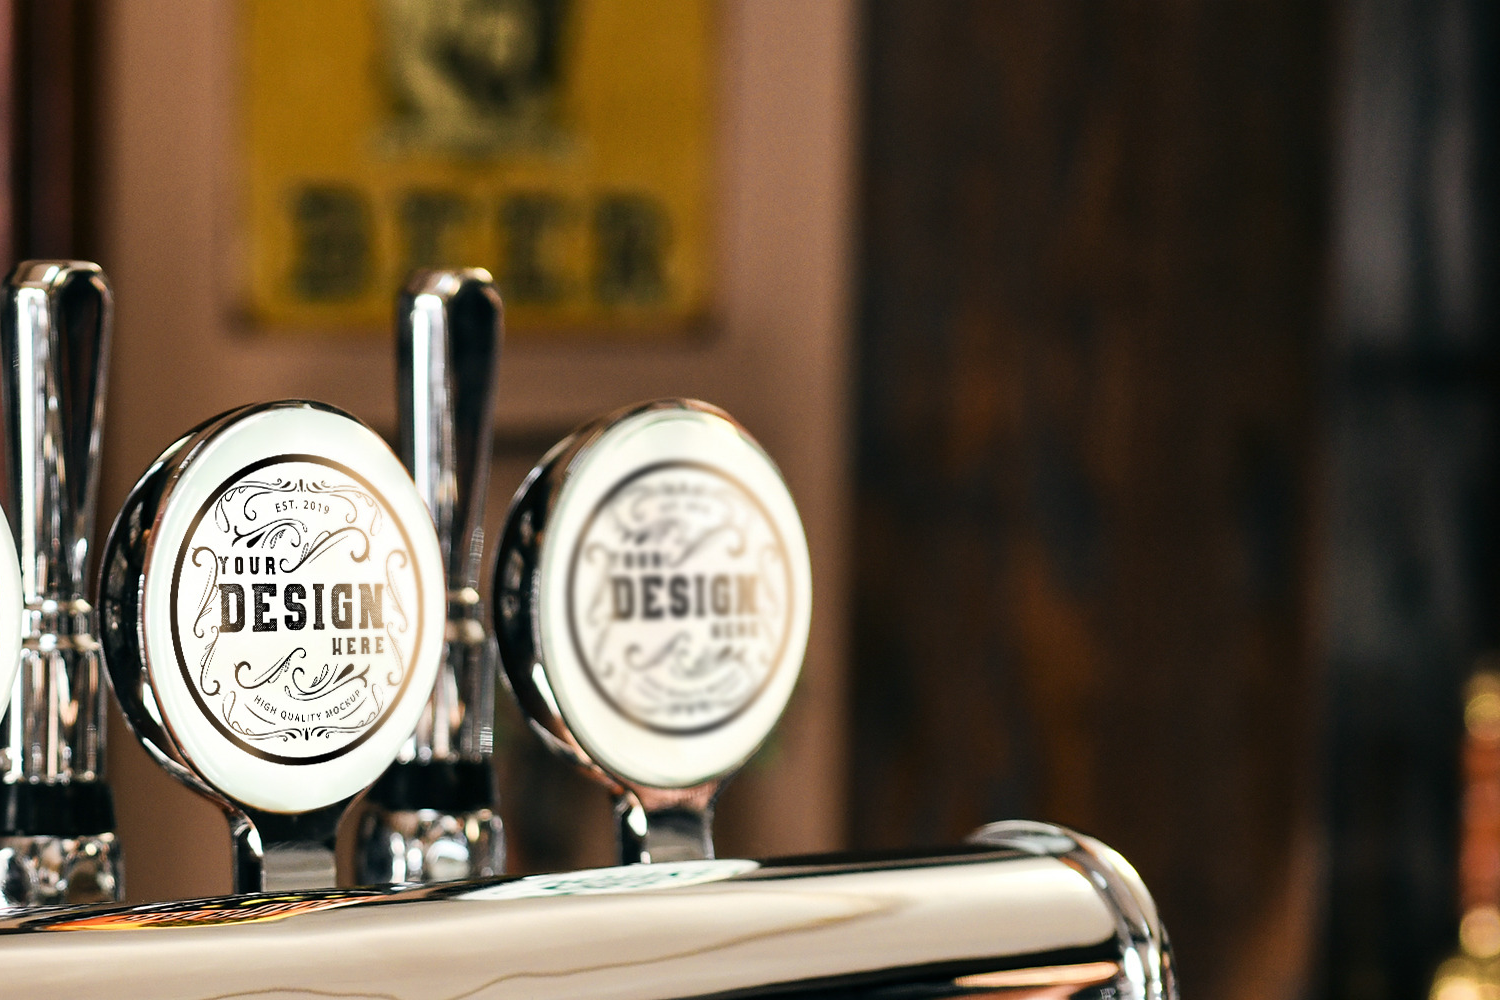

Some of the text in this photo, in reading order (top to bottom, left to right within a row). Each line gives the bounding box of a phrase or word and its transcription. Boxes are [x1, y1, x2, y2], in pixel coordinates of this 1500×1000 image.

[276, 500, 330, 514] EST. 2019
[218, 556, 276, 575] YOUR
[218, 584, 384, 633] DESIGN
[611, 575, 757, 620] DESIGN
[332, 637, 384, 655] HERE
[254, 690, 361, 722] HIGH QUALITY MOCKUP
